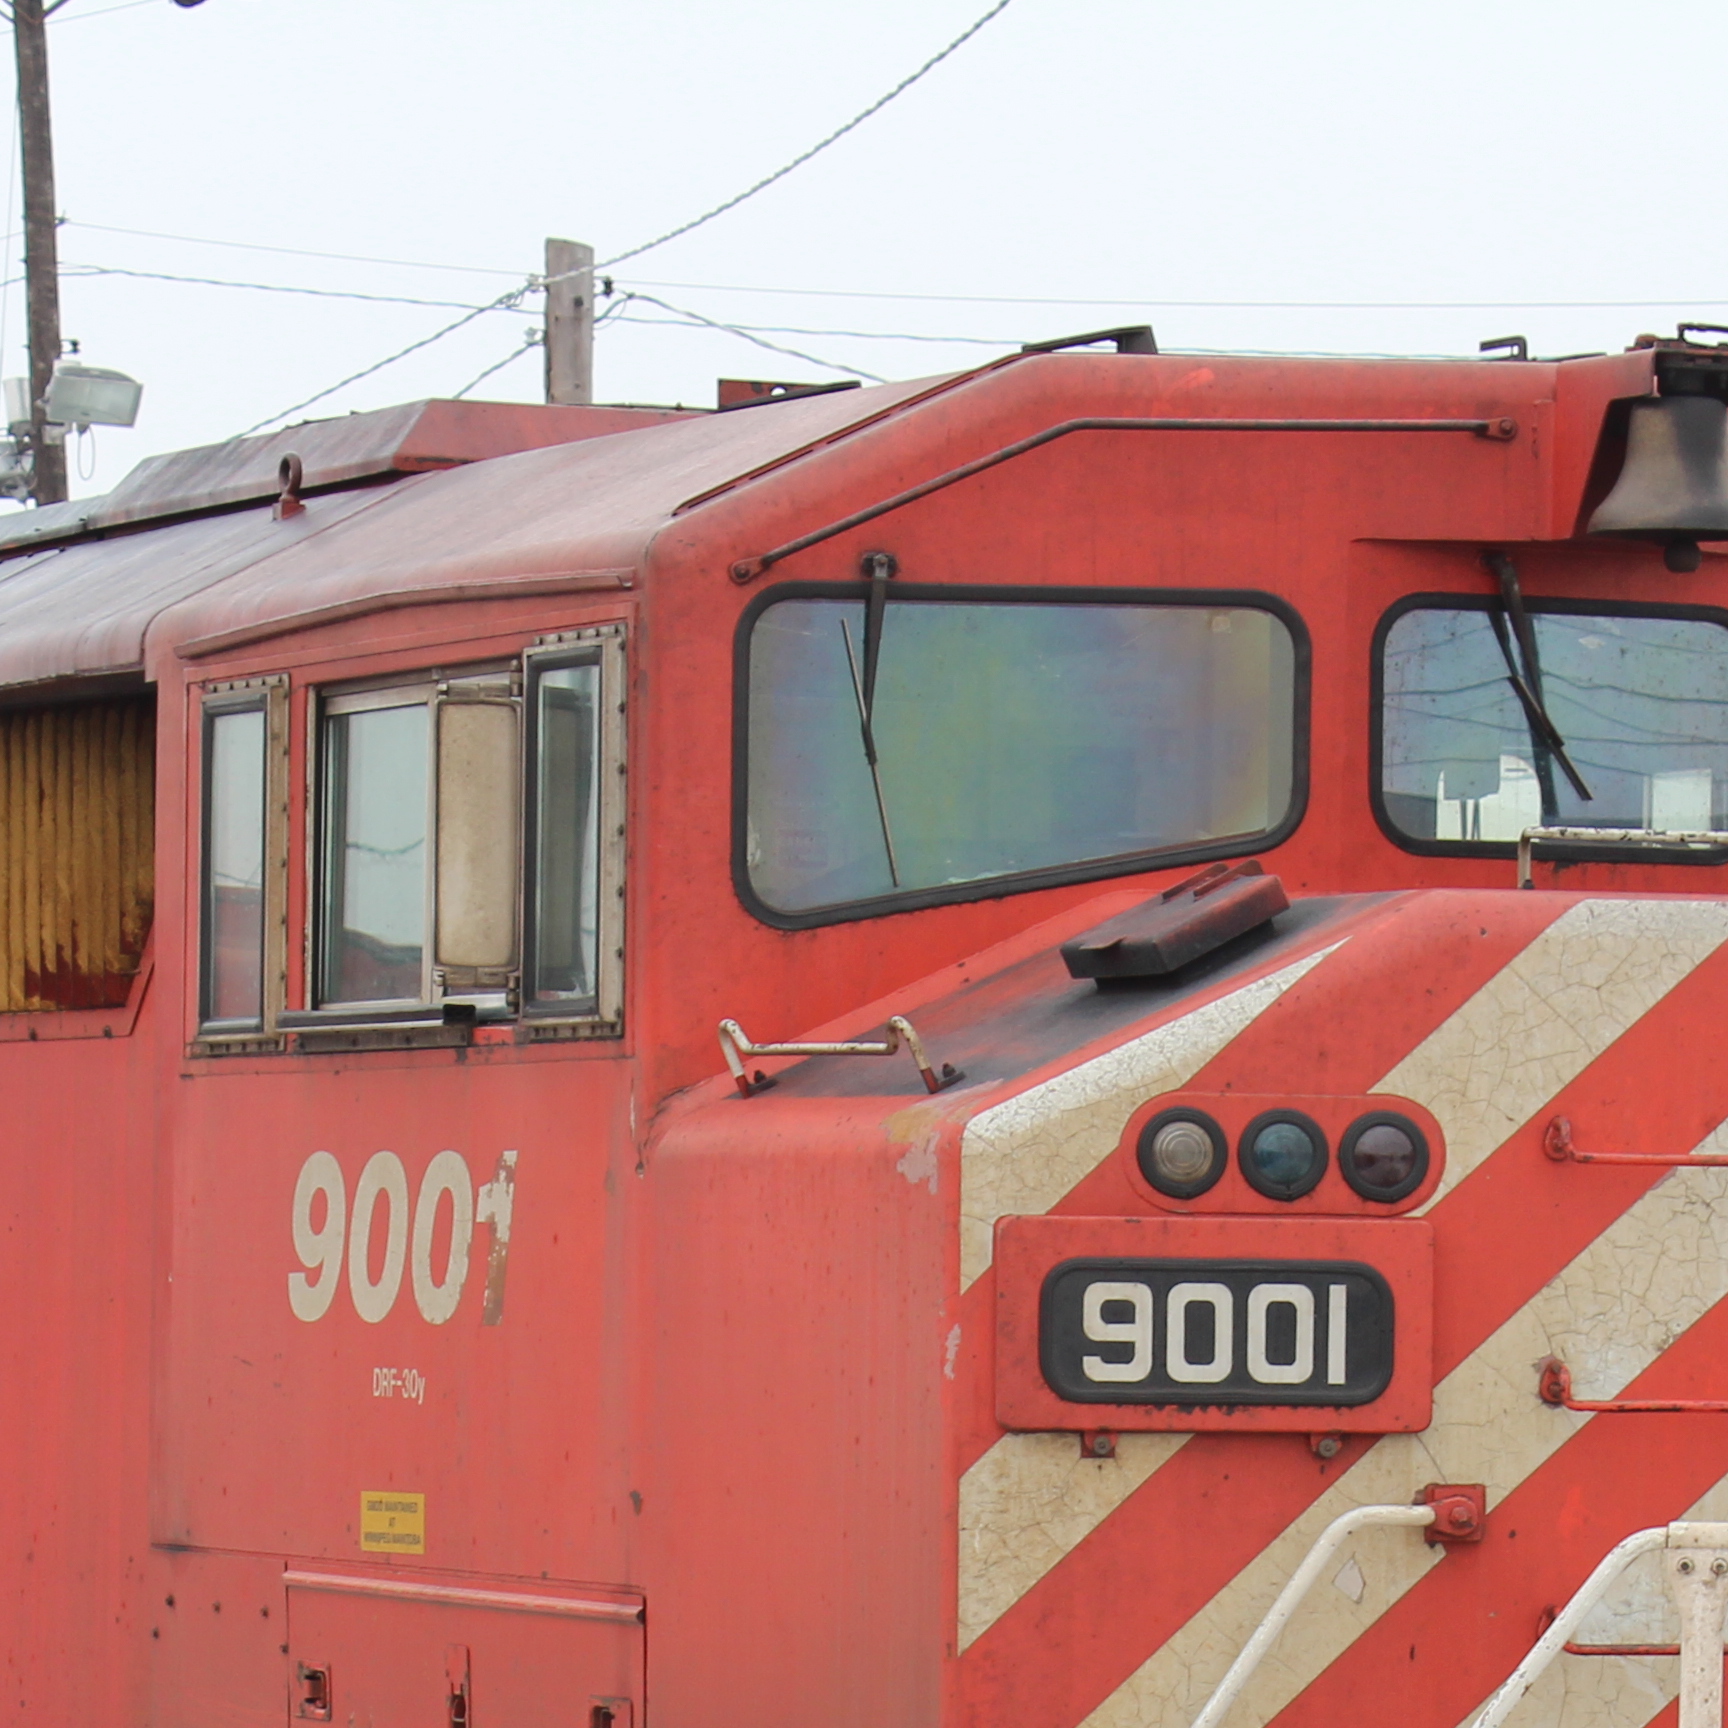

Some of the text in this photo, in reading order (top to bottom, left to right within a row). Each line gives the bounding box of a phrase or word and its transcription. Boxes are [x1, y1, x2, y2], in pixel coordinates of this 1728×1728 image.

[288, 1150, 518, 1326] 9001
[1081, 1280, 1348, 1385] 9001
[373, 1367, 425, 1405] DRF-30y
